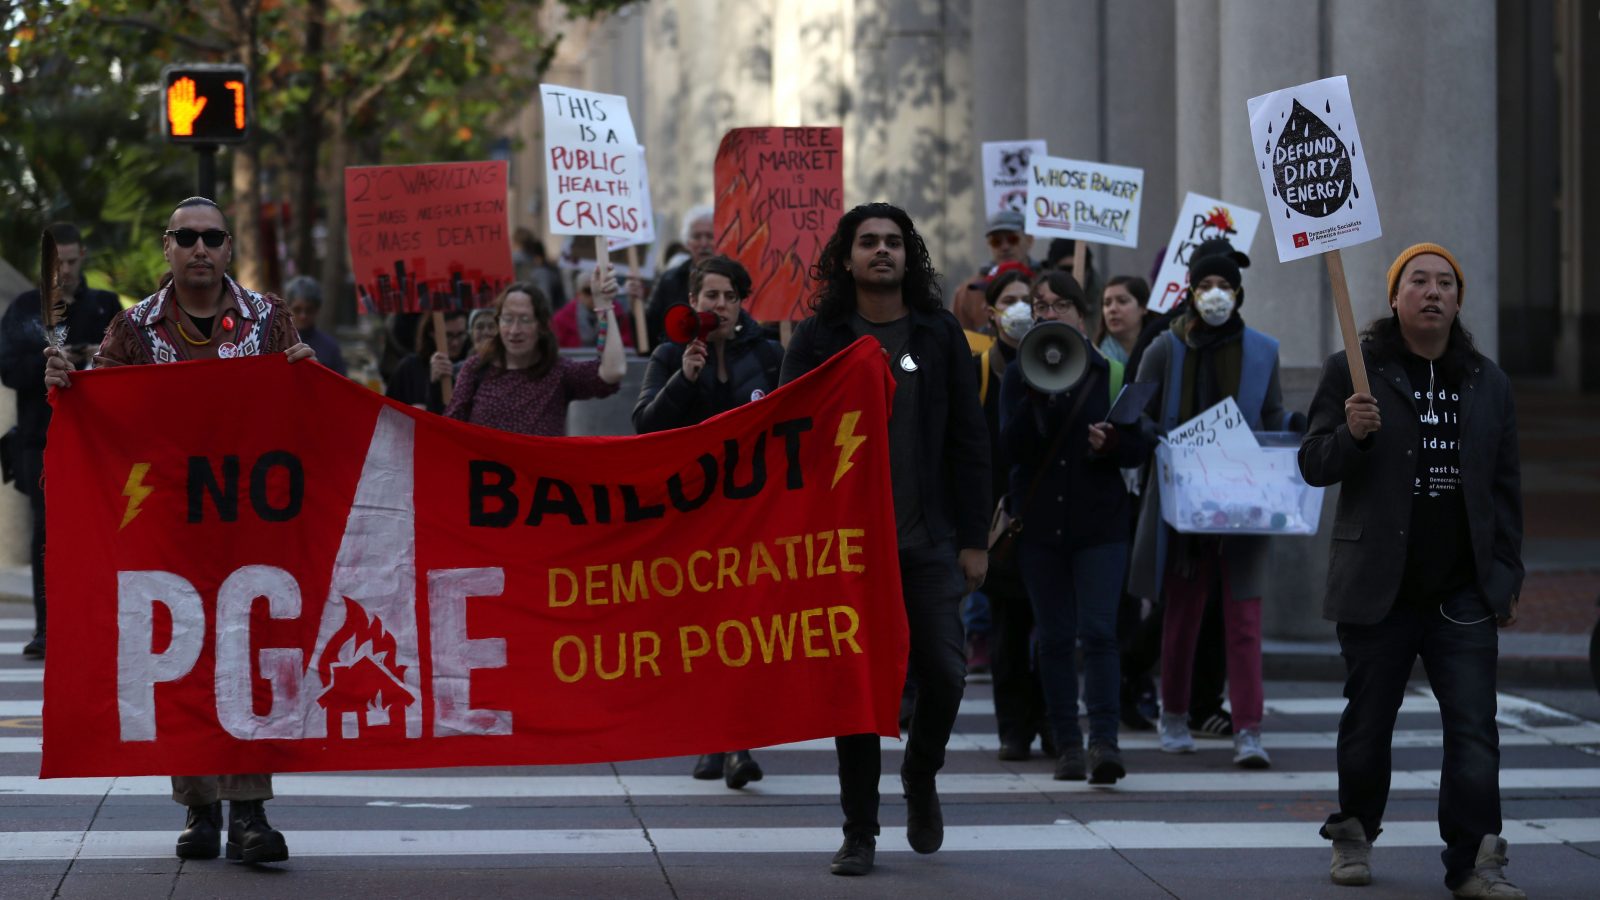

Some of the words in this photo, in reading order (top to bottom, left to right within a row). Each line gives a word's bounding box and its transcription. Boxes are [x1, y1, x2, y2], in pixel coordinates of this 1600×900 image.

[224, 81, 244, 129] 7
[547, 92, 607, 121] THIS
[580, 124, 597, 142] IS
[606, 129, 619, 143] A
[748, 130, 772, 145] THE
[783, 127, 833, 148] FREE
[551, 146, 626, 175] PUBLIC
[759, 149, 838, 170] MARKET
[1276, 136, 1337, 165] DEFUND
[401, 165, 497, 195] WARMING
[793, 173, 805, 184] IS
[1033, 165, 1088, 191] WHOSE
[1090, 171, 1139, 203] POWER?
[1284, 158, 1340, 185] DIRTY
[558, 175, 629, 197] HEALTH
[768, 188, 840, 209] KILLING
[1286, 180, 1345, 205] ENERGY
[378, 209, 407, 224] MASS
[417, 200, 503, 220] MIGRATION
[557, 200, 638, 232] CRISIS
[792, 210, 825, 231] US!
[1034, 197, 1072, 221] OUR
[1074, 200, 1131, 234] POWER!
[377, 231, 421, 251] MASS
[438, 225, 502, 247] DEATH
[1308, 226, 1337, 237] Democratic
[1336, 220, 1362, 230] Socialists
[1315, 232, 1336, 241] America
[1211, 403, 1228, 426] IT
[1224, 411, 1242, 429] TO
[1170, 419, 1205, 446] DOWN
[187, 449, 304, 524] NO
[468, 416, 814, 529] BAILOUT
[1429, 466, 1448, 474] east
[547, 528, 866, 608] DEMOCRATIZE
[552, 628, 662, 683] OUR
[678, 605, 863, 674] POWER
